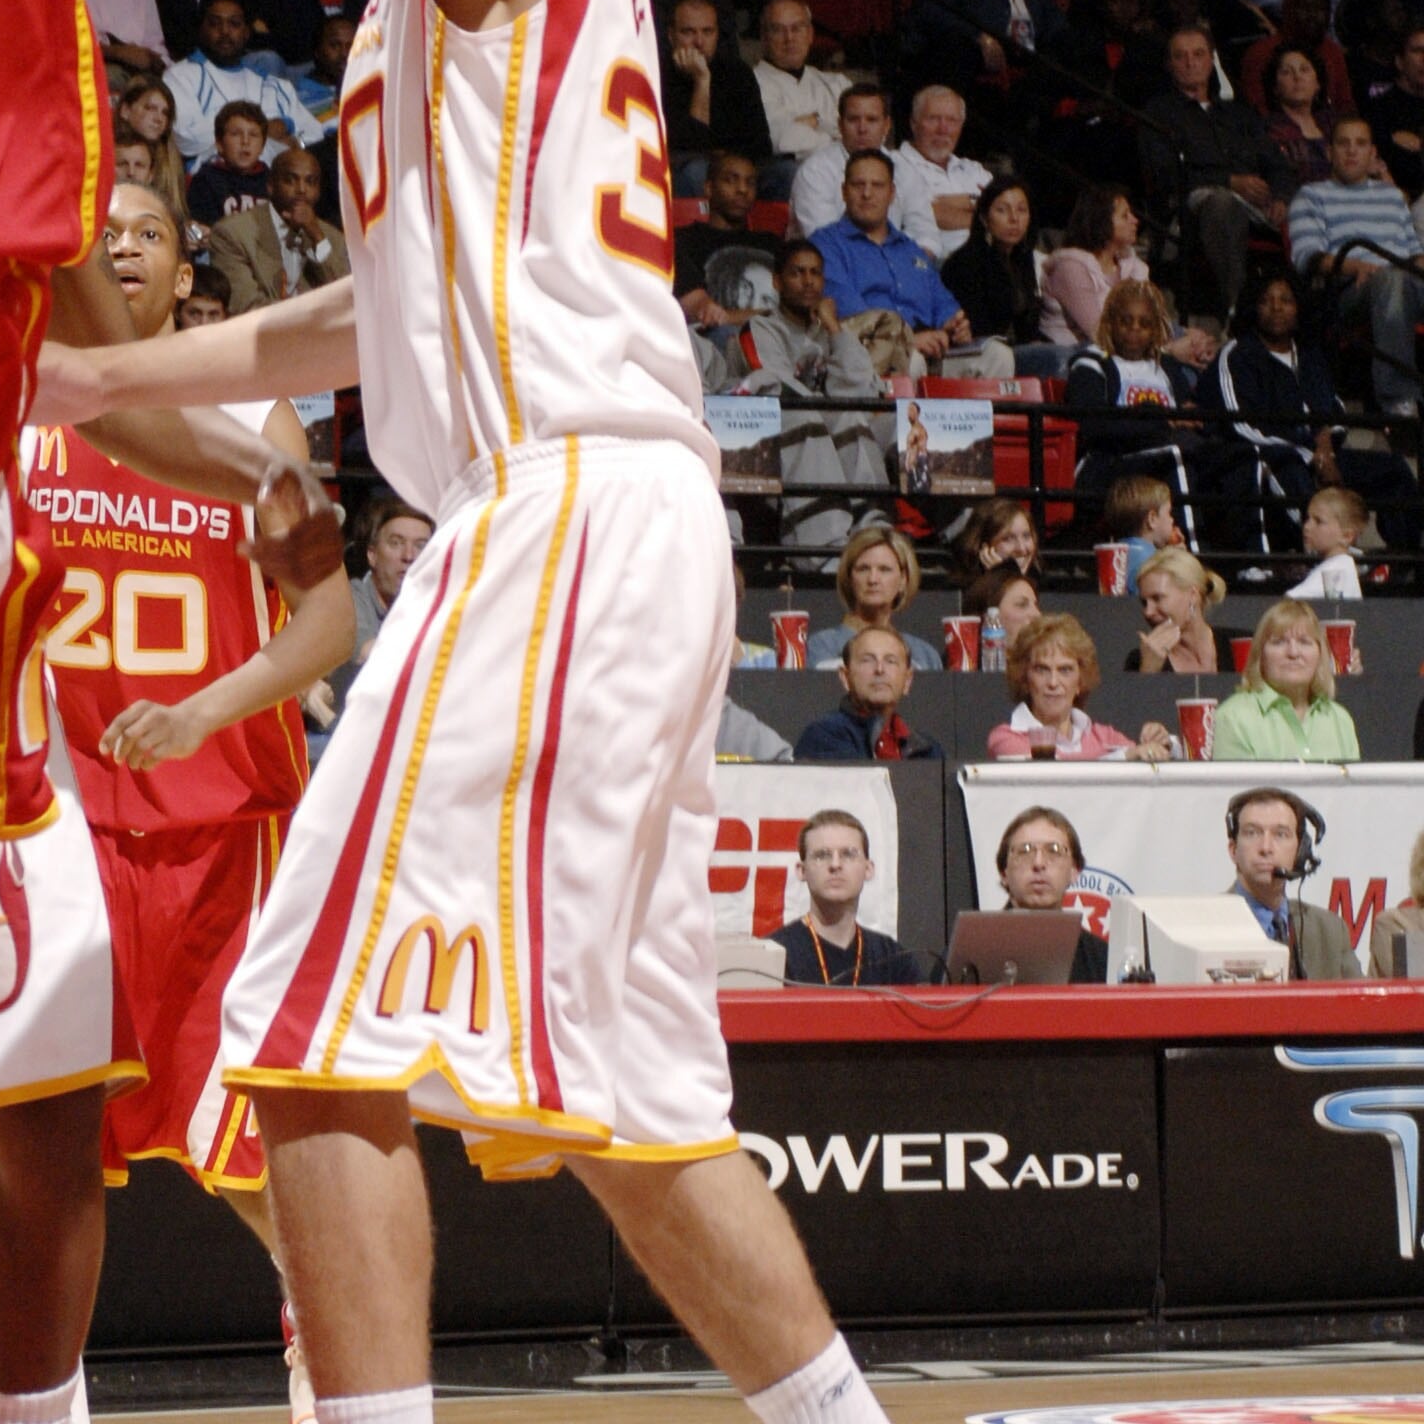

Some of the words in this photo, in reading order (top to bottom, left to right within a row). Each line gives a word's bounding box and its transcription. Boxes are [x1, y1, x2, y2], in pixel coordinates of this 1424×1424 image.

[51, 528, 76, 548] LL
[81, 528, 193, 559] AMERICAN
[45, 566, 209, 675] 20
